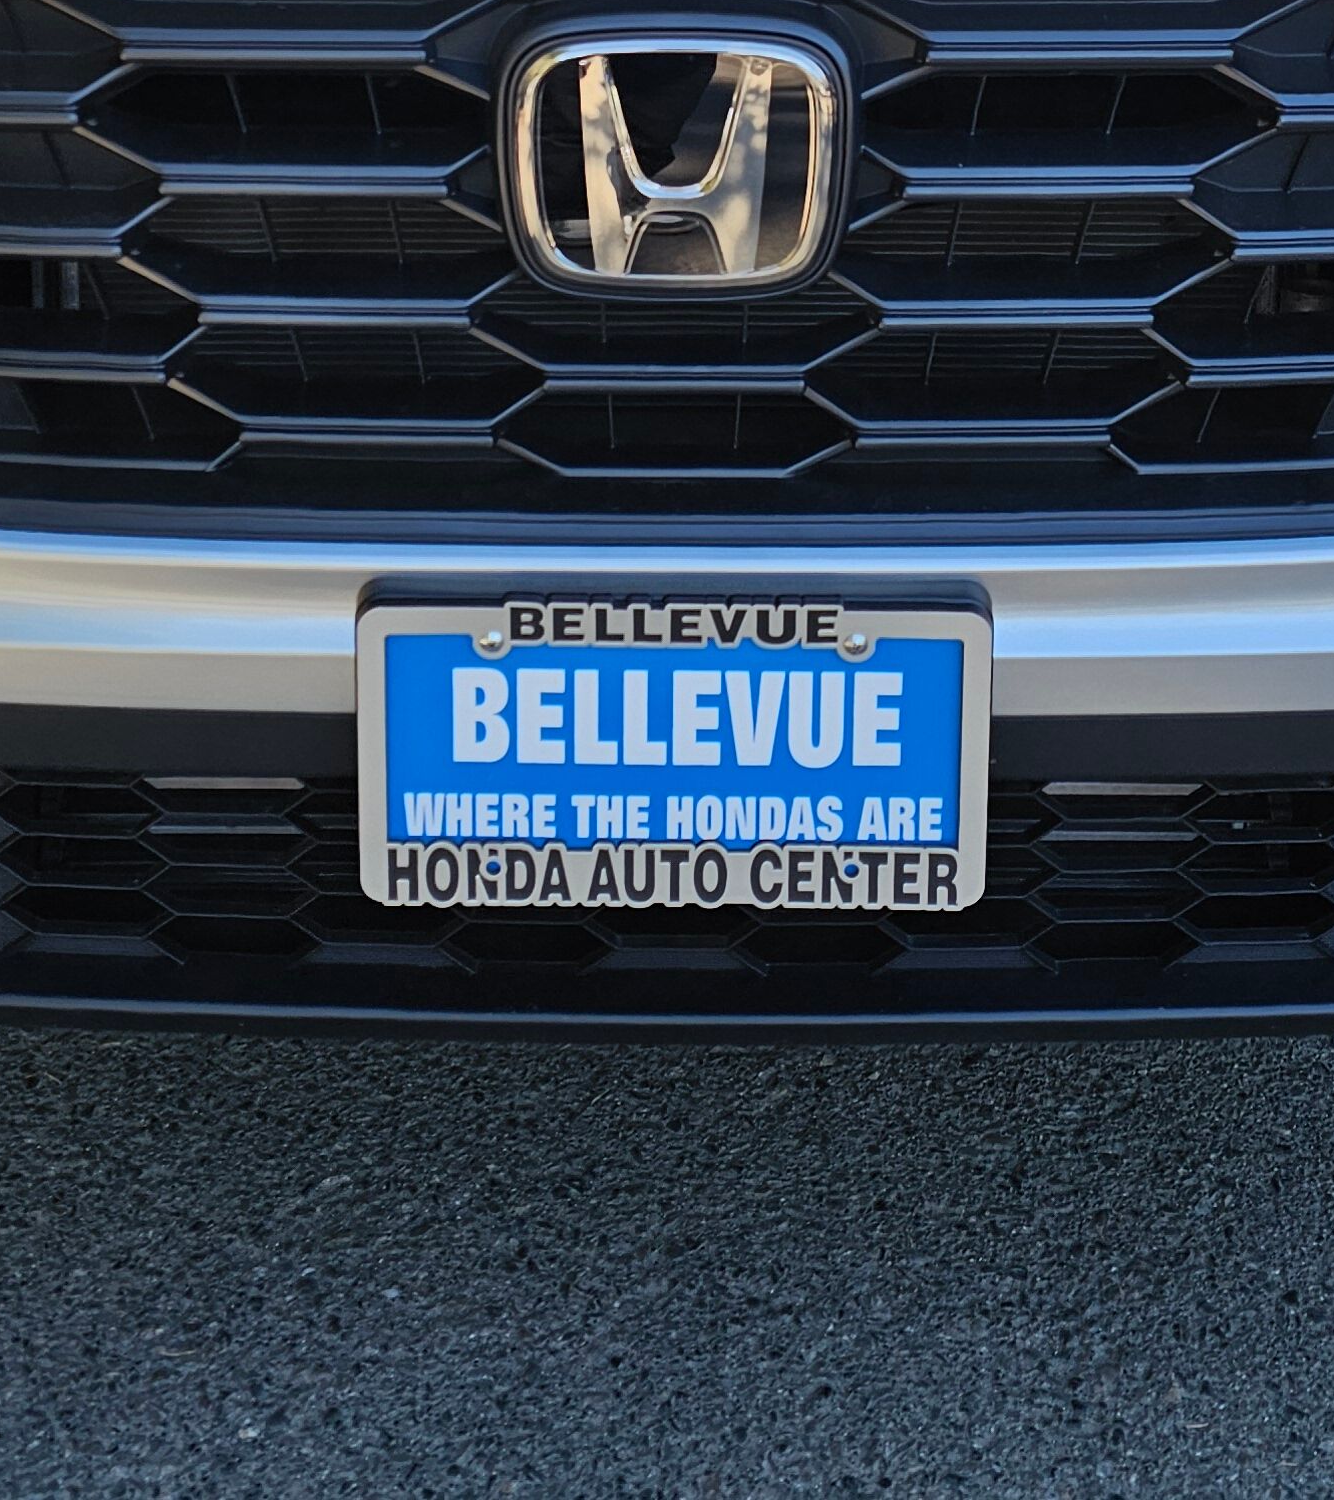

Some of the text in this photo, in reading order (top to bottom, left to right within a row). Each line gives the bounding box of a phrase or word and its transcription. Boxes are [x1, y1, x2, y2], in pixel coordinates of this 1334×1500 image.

[509, 606, 840, 646] BELLEVUE
[452, 666, 904, 769] BELLEVUE
[403, 791, 944, 842] WHERE THE HONDAS ARE
[387, 846, 958, 907] HONDA AUTO CENTER
